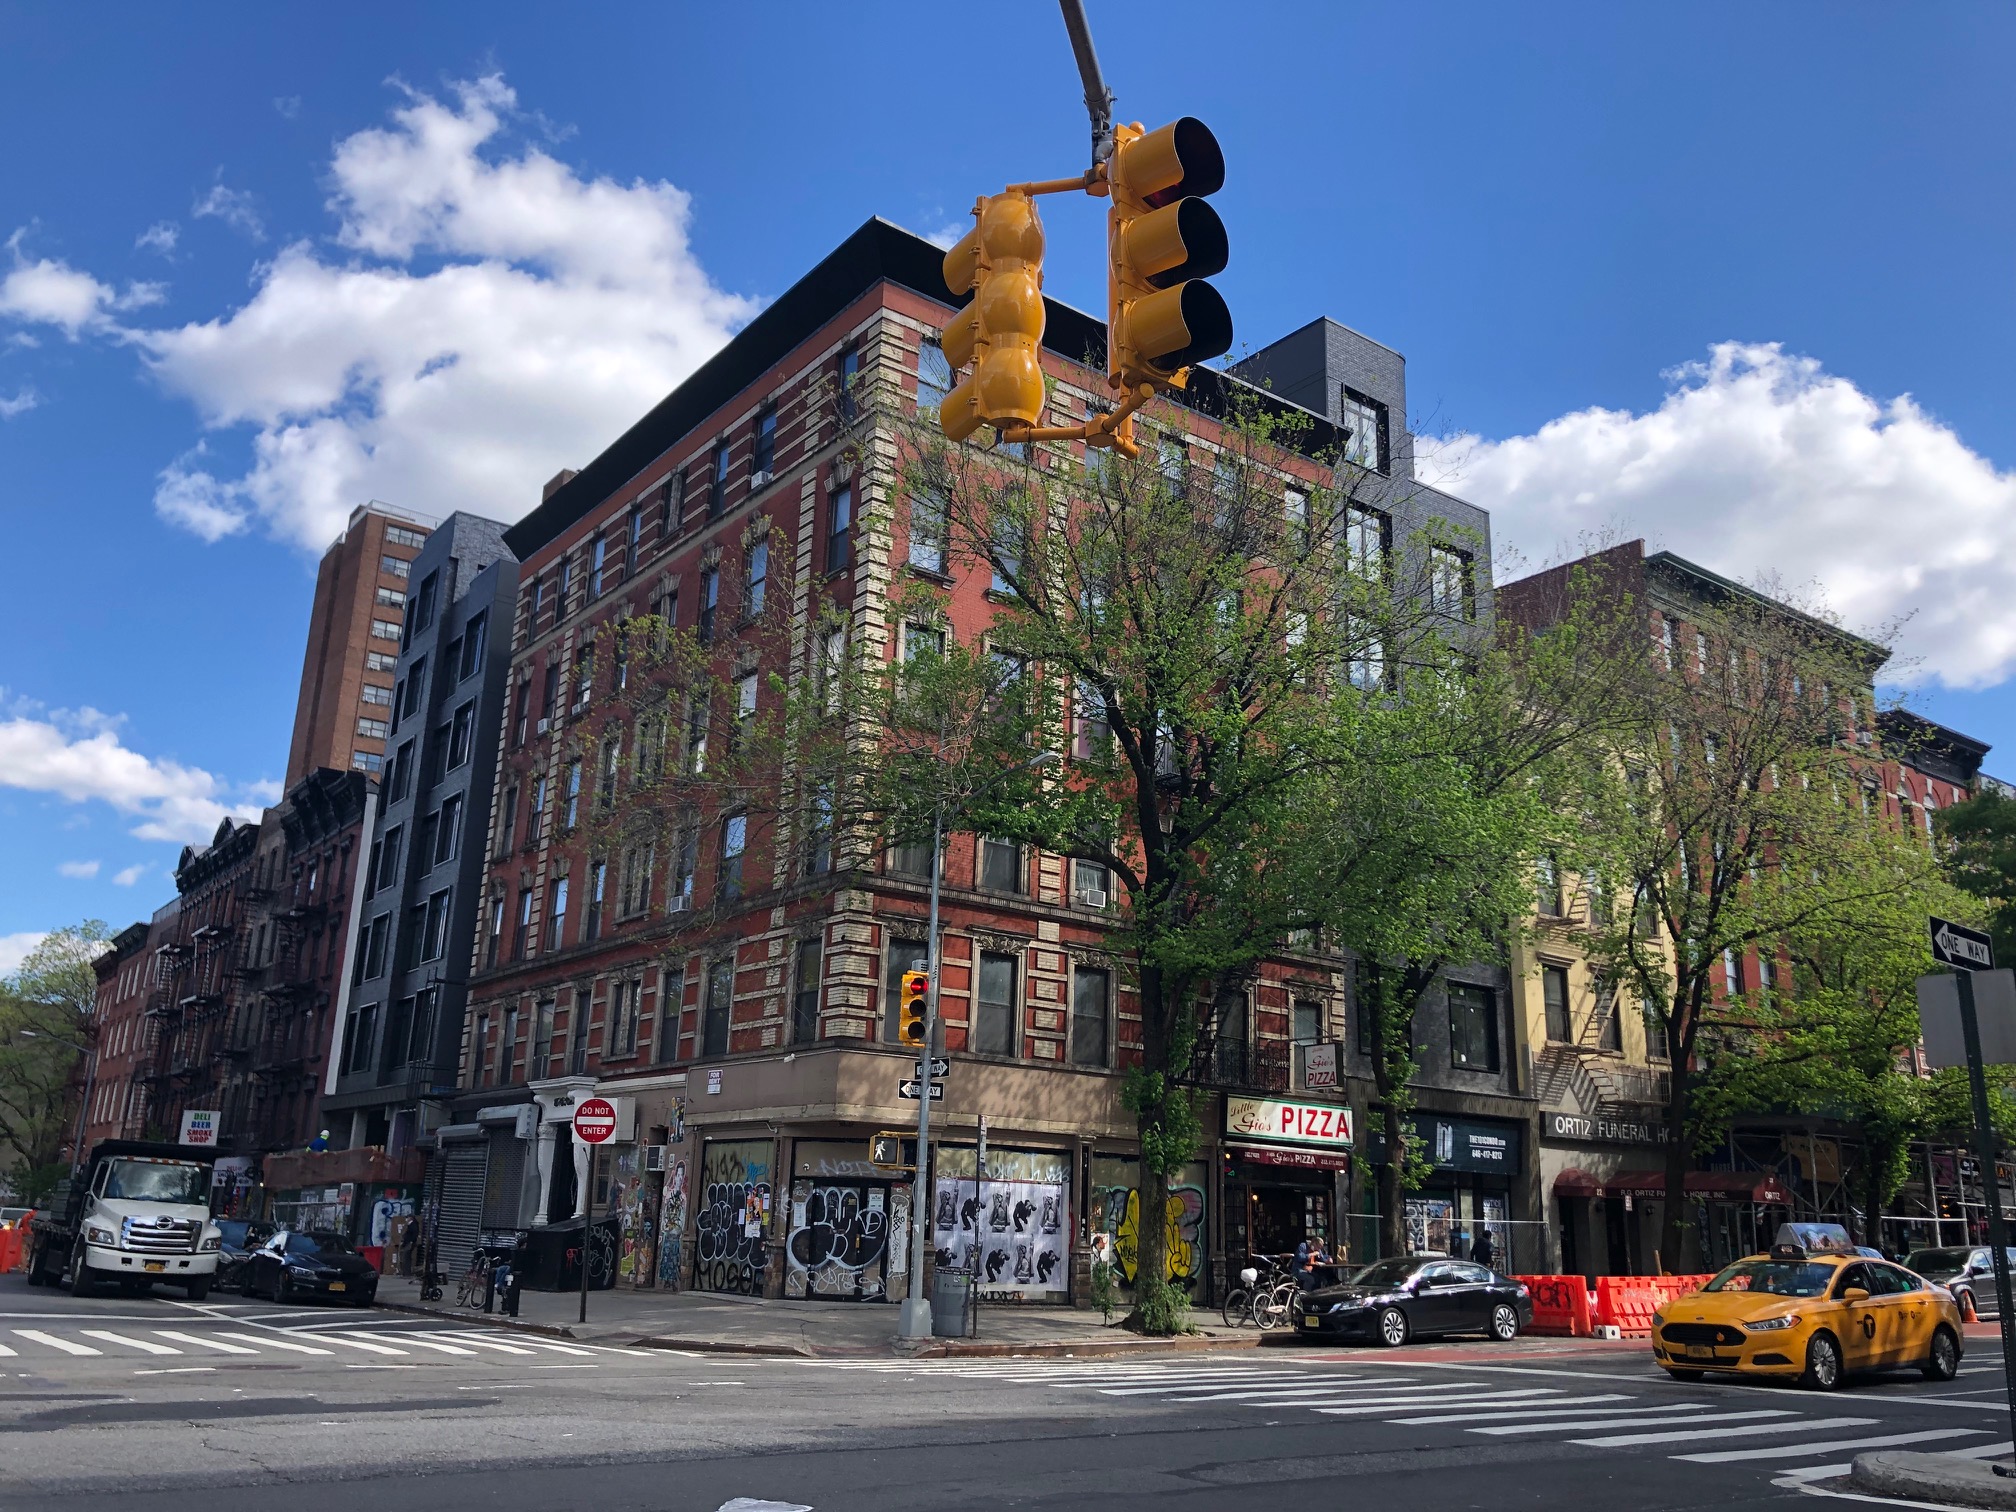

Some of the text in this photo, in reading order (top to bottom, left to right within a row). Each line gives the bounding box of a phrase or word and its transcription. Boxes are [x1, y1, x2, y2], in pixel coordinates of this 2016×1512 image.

[1941, 933, 1985, 961] ONE WAY
[1307, 1071, 1336, 1086] PIZZA
[905, 1085, 919, 1095] ONE
[581, 1107, 610, 1115] DO NOT
[1230, 1101, 1255, 1118] Little
[193, 1112, 211, 1121] DELI
[190, 1121, 211, 1129] BEER
[1232, 1106, 1351, 1140] Gio's PIZZA
[186, 1128, 214, 1137] SMOKE
[582, 1126, 607, 1136] ENTER
[1555, 1116, 1592, 1136] ORTIZ
[1598, 1120, 1653, 1142] FUNERAL
[188, 1136, 210, 1144] SHOP
[1294, 1154, 1316, 1165] PIZZA
[1764, 1191, 1781, 1201] ORTIZ
